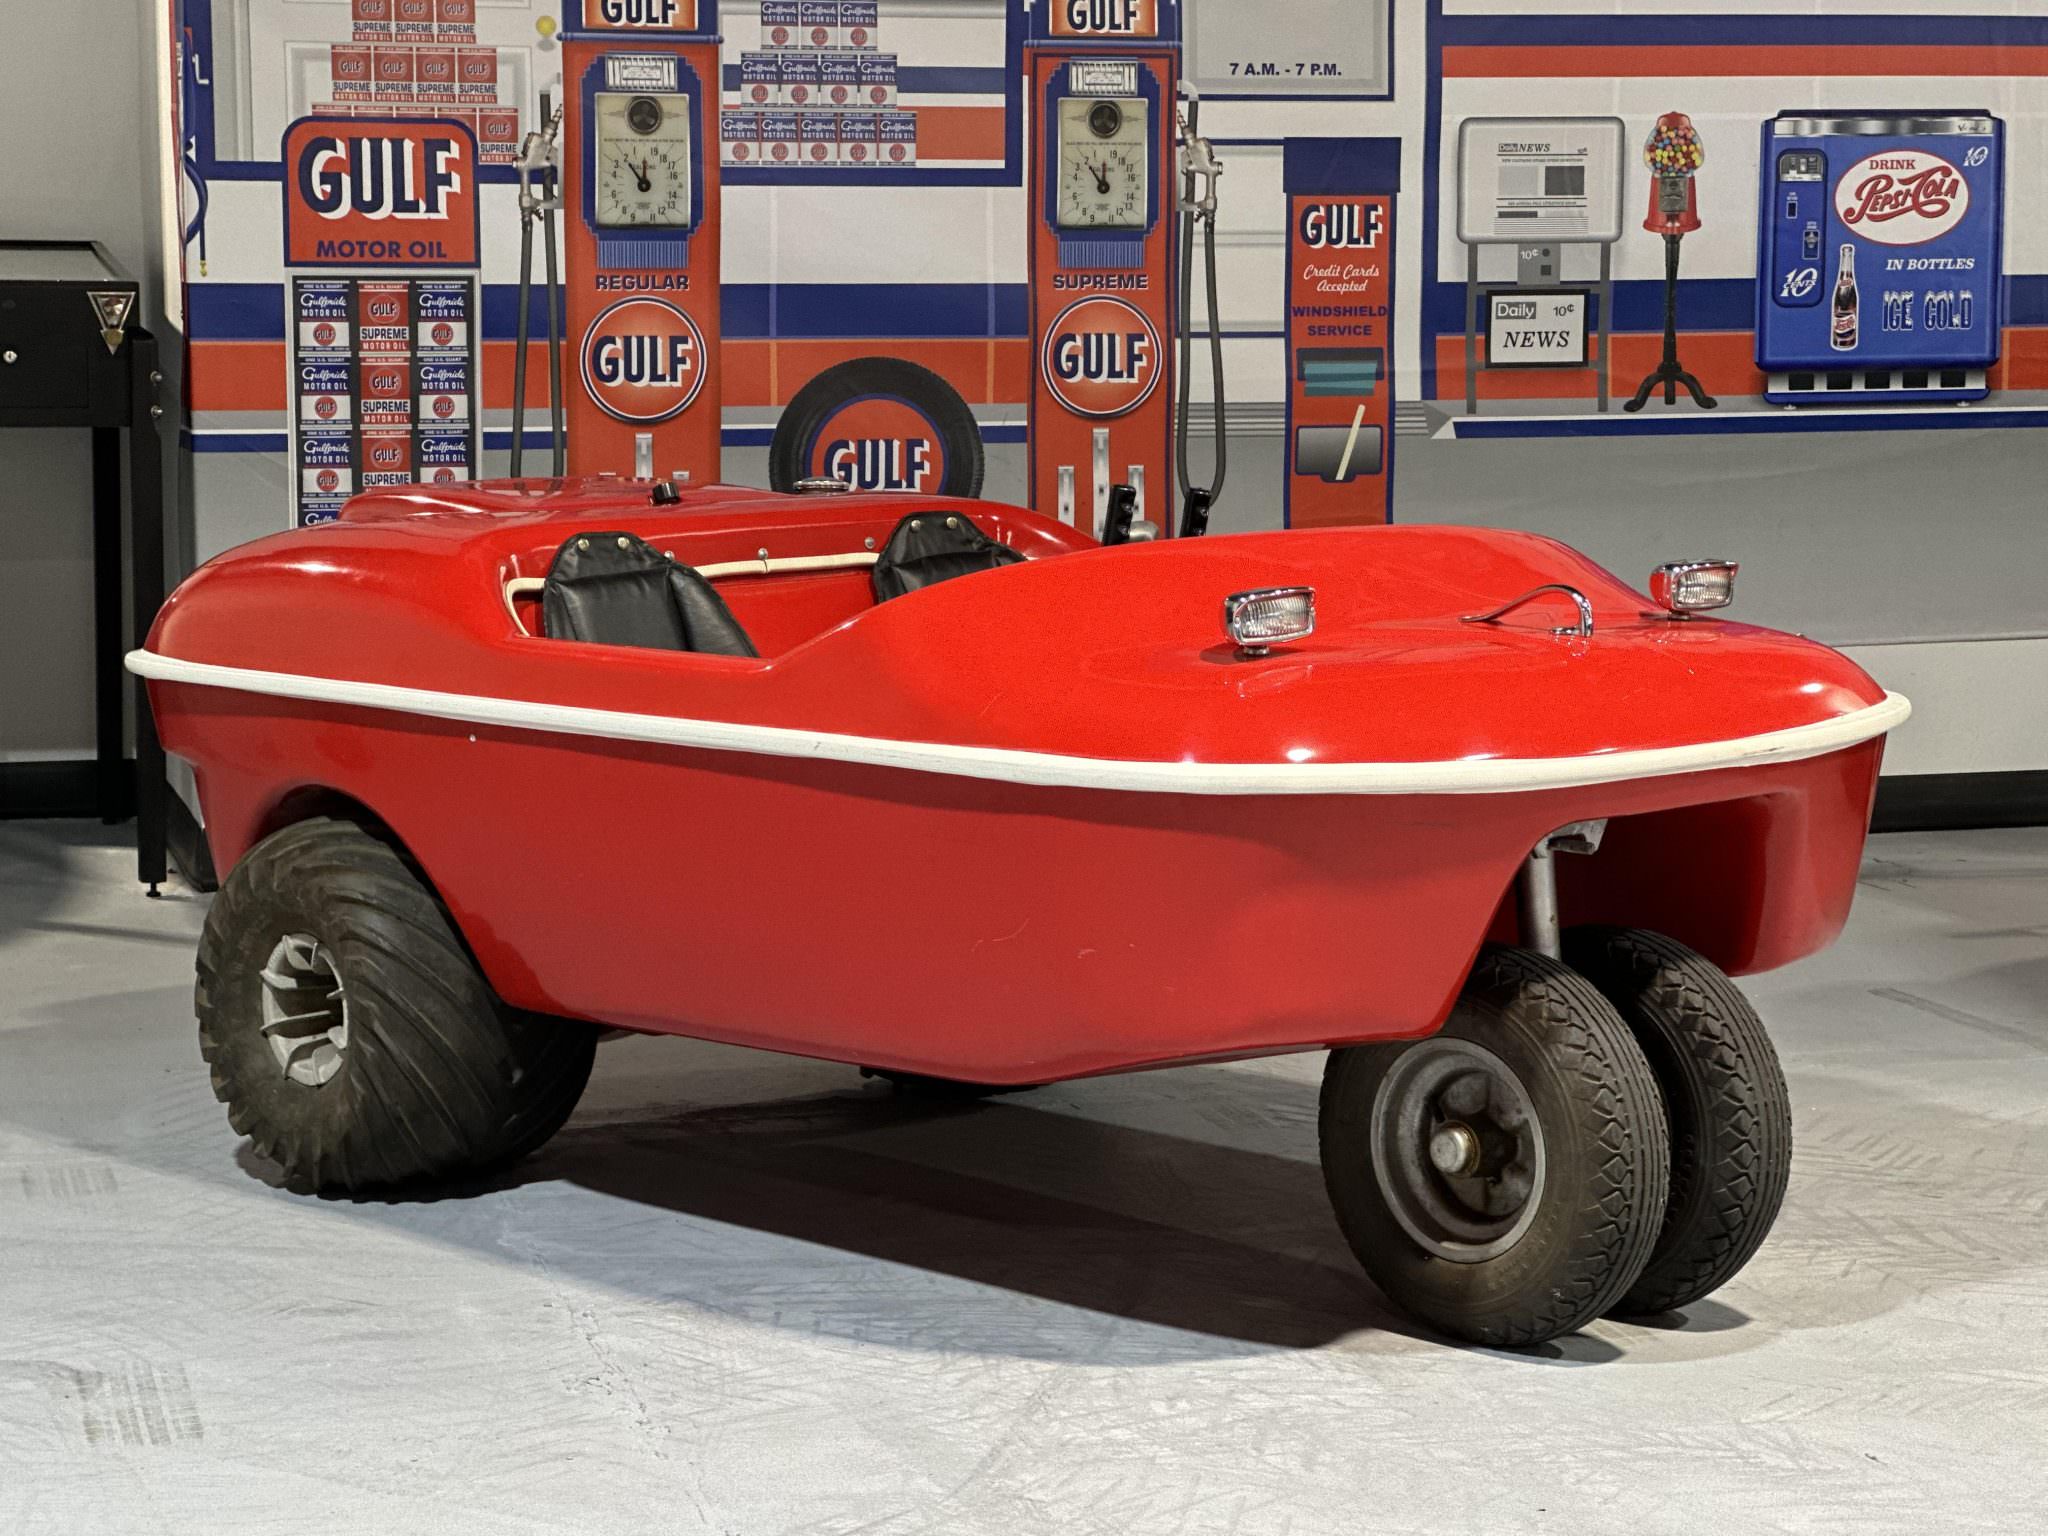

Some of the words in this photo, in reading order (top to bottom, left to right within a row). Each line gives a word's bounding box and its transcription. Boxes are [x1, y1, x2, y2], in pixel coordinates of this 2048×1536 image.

[600, 0, 680, 27] GULF
[1067, 0, 1139, 33] GULF
[353, 22, 391, 32] SUPREME
[395, 23, 433, 33] SUPREME
[438, 24, 475, 33] SUPREME
[341, 60, 362, 72] GULF
[383, 61, 404, 73] GULF
[425, 63, 446, 75] GULF
[466, 63, 488, 75] GULF
[1229, 63, 1240, 76] 7
[1244, 63, 1280, 76] A.M.
[1295, 63, 1305, 76] 7
[1310, 63, 1342, 76] P.M.
[333, 82, 370, 91] SUPREME
[375, 83, 412, 92] SUPREME
[417, 84, 454, 93] SUPREME
[459, 84, 496, 94] SUPREME
[480, 144, 517, 153] SUPREME
[1519, 143, 1550, 152] NEWS
[1869, 159, 1916, 170] DRINK
[298, 135, 461, 220] GULF
[1300, 204, 1382, 249] GULF
[315, 240, 402, 258] MOTOR
[408, 240, 447, 258] OIL
[1886, 259, 1905, 270] IN
[1907, 258, 1975, 270] BOTTLES
[1303, 264, 1341, 280] Credit
[1343, 263, 1379, 278] Cards
[595, 274, 690, 291] REGULAR
[1053, 274, 1149, 290] SUPREME
[1316, 280, 1367, 294] Accepted
[300, 293, 347, 307] Gulfpride
[419, 293, 464, 307] Gulfpride
[370, 303, 399, 316] GULF
[1292, 306, 1388, 317] WINDSHIELD
[1498, 304, 1534, 319] Daily
[1553, 304, 1575, 317] 10¢
[1881, 291, 1913, 331] ICE
[1924, 290, 1973, 330] COLD
[361, 328, 407, 339] SUPREME
[1307, 325, 1372, 336] SERVICE
[363, 342, 390, 350] MOTOR
[393, 342, 406, 350] OIL
[1503, 330, 1570, 349] NEWS
[592, 335, 693, 387] GULF
[1053, 333, 1150, 384] GULF
[301, 366, 348, 380] Gulfpride
[420, 366, 465, 380] Gulfpride
[304, 382, 331, 390] MOTOR
[334, 382, 348, 390] OIL
[372, 375, 400, 389] GULF
[422, 382, 449, 390] MOTOR
[452, 382, 464, 390] OIL
[363, 401, 409, 412] SUPREME
[364, 415, 391, 423] MOTOR
[394, 415, 408, 423] OIL
[303, 440, 349, 454] Gulfpride
[421, 439, 466, 453] Gulfpride
[374, 448, 401, 463] GULF
[423, 454, 450, 462] MOTOR
[453, 454, 465, 462] OIL
[823, 438, 931, 493] GULF
[364, 473, 409, 485] SUPREME
